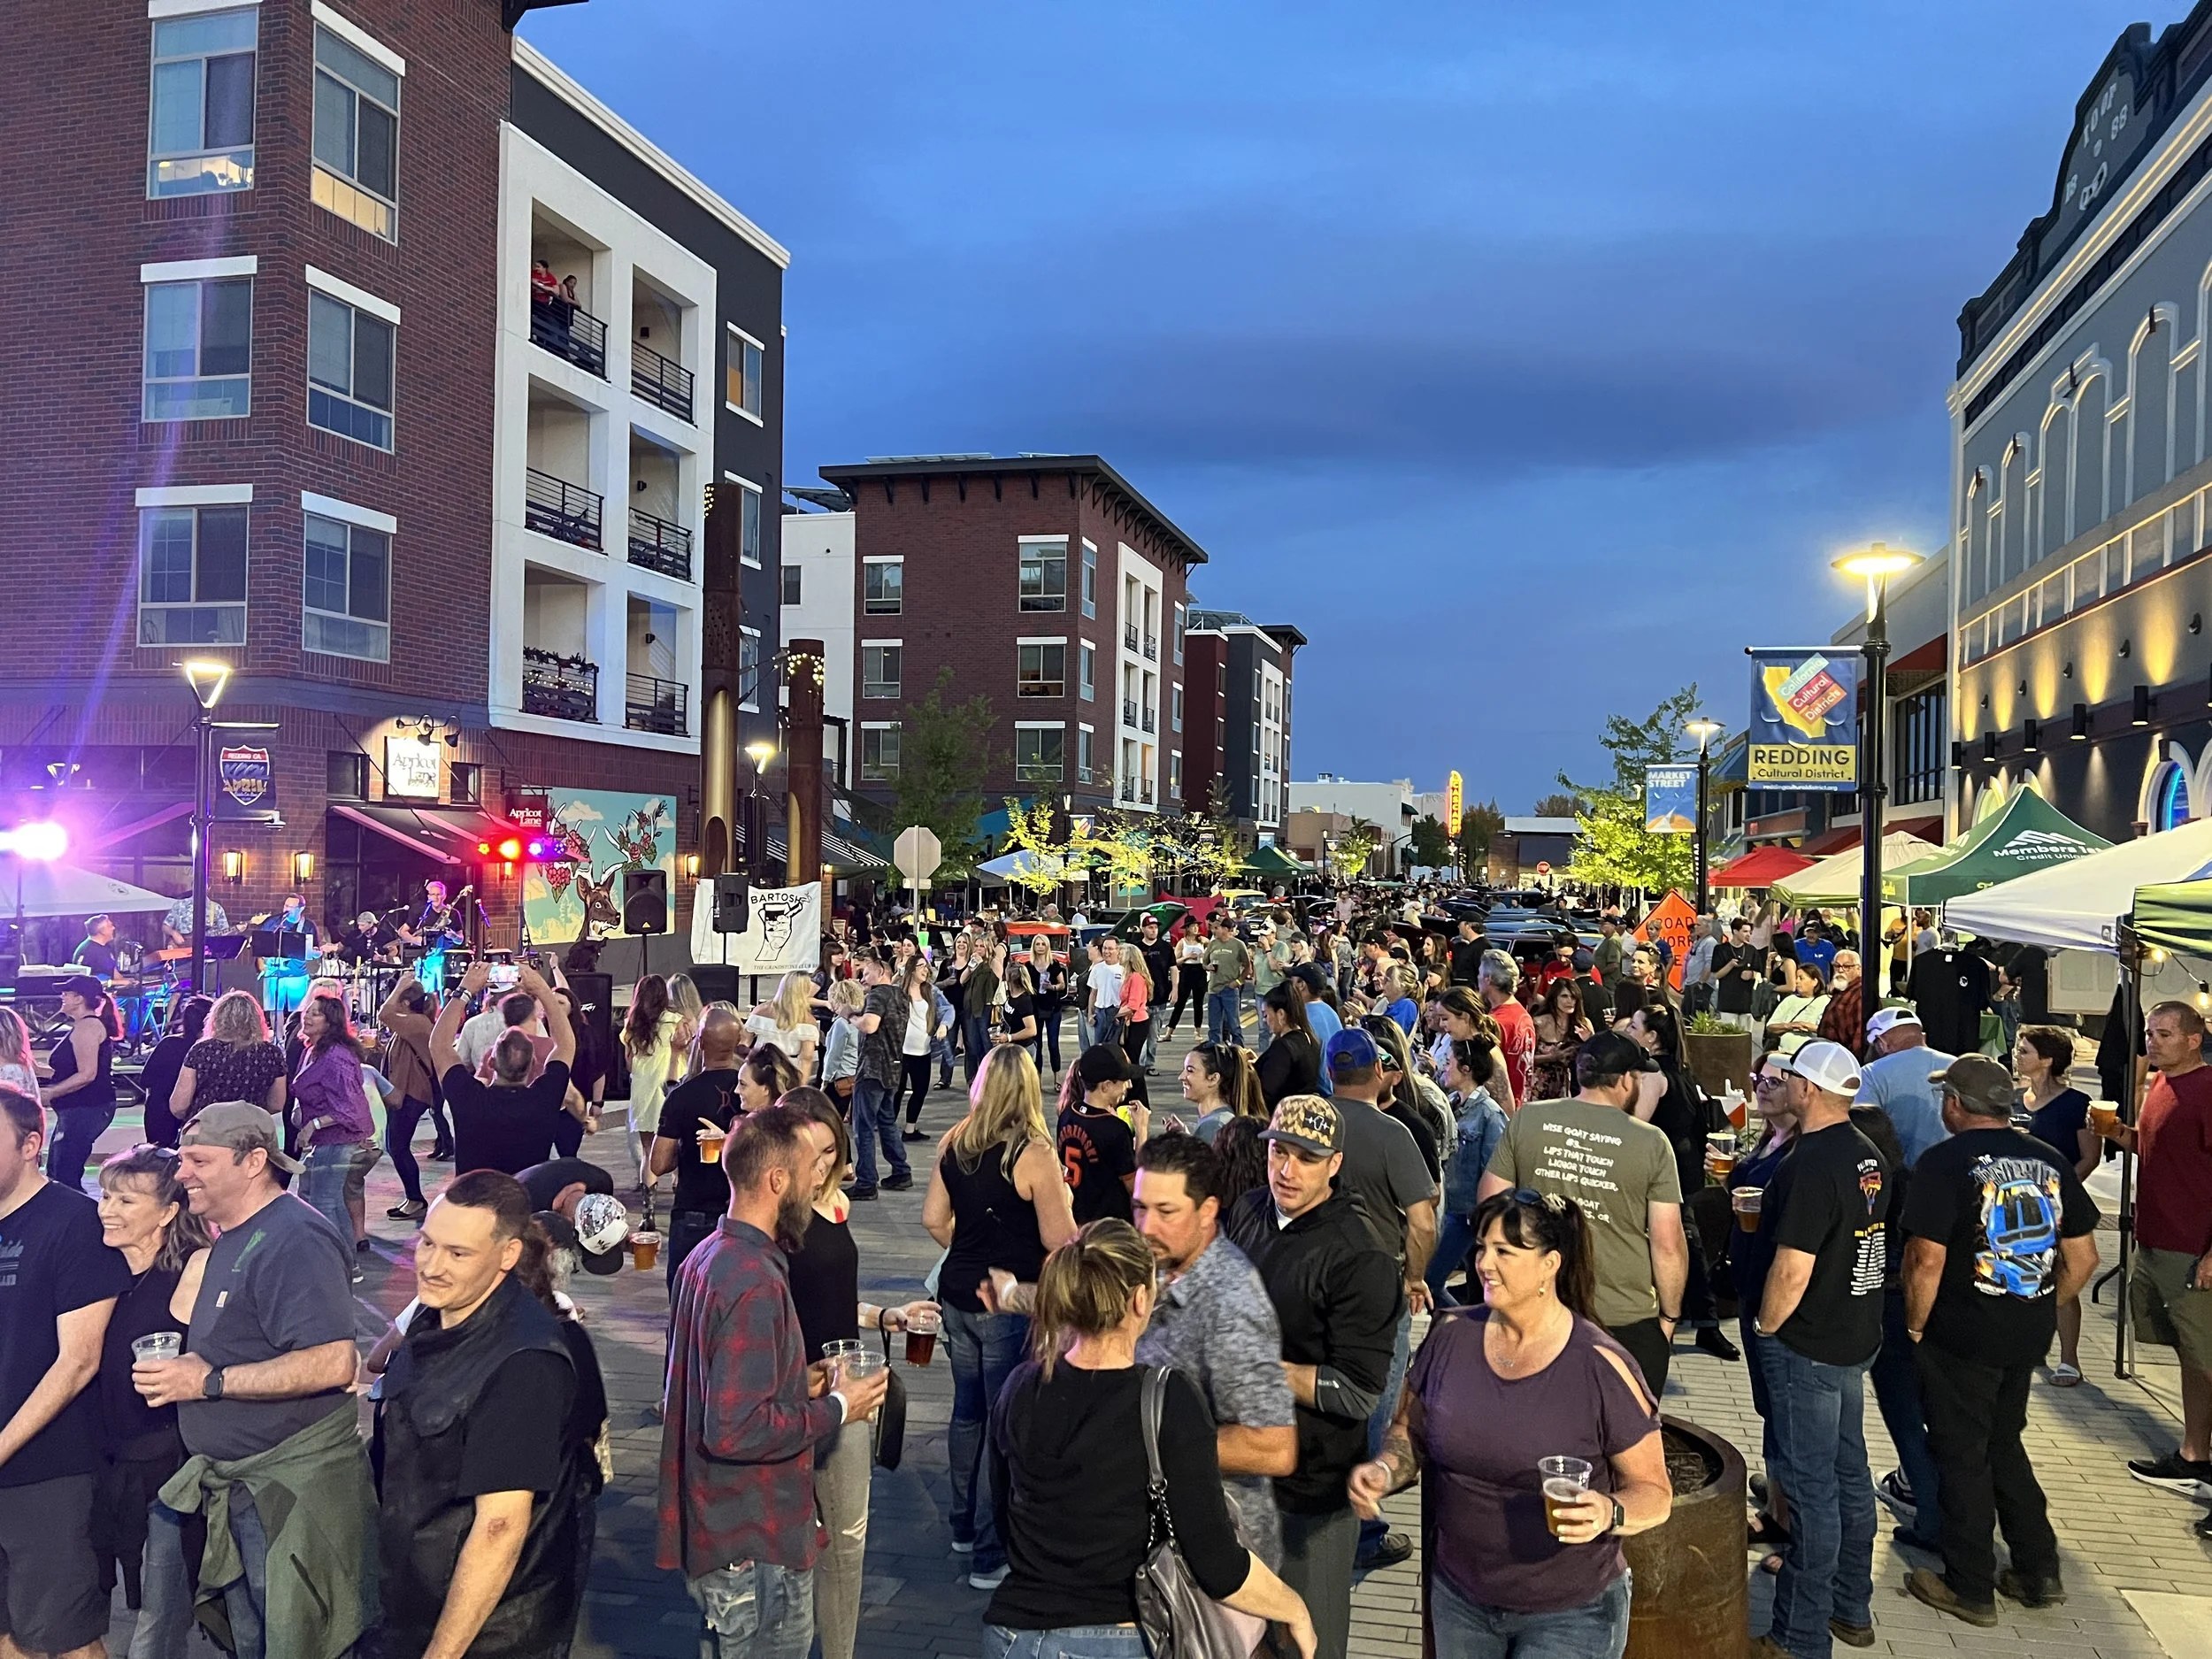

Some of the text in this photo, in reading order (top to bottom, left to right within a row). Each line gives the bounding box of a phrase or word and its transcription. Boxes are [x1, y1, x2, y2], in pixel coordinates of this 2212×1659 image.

[1780, 657, 1824, 697] California
[1793, 674, 1831, 708] Cultural
[1804, 688, 1842, 721] Districts
[1754, 749, 1850, 765] REDDING
[1648, 771, 1693, 780] MARKET
[1757, 768, 1845, 780] Cultural District
[1648, 779, 1686, 788] STREET
[509, 807, 542, 819] Apricot
[519, 816, 542, 825] Lane
[1993, 845, 2078, 857] Members
[1542, 1123, 1623, 1147] WISE GOAT SAYING
[1543, 1146, 1615, 1168] LIPS THAT TOUCH
[1064, 1145, 1082, 1188] 5
[1548, 1157, 1607, 1178] LIQUOR TOUCH
[1534, 1168, 1562, 1180] OTHER
[1562, 1171, 1578, 1183] LIPS
